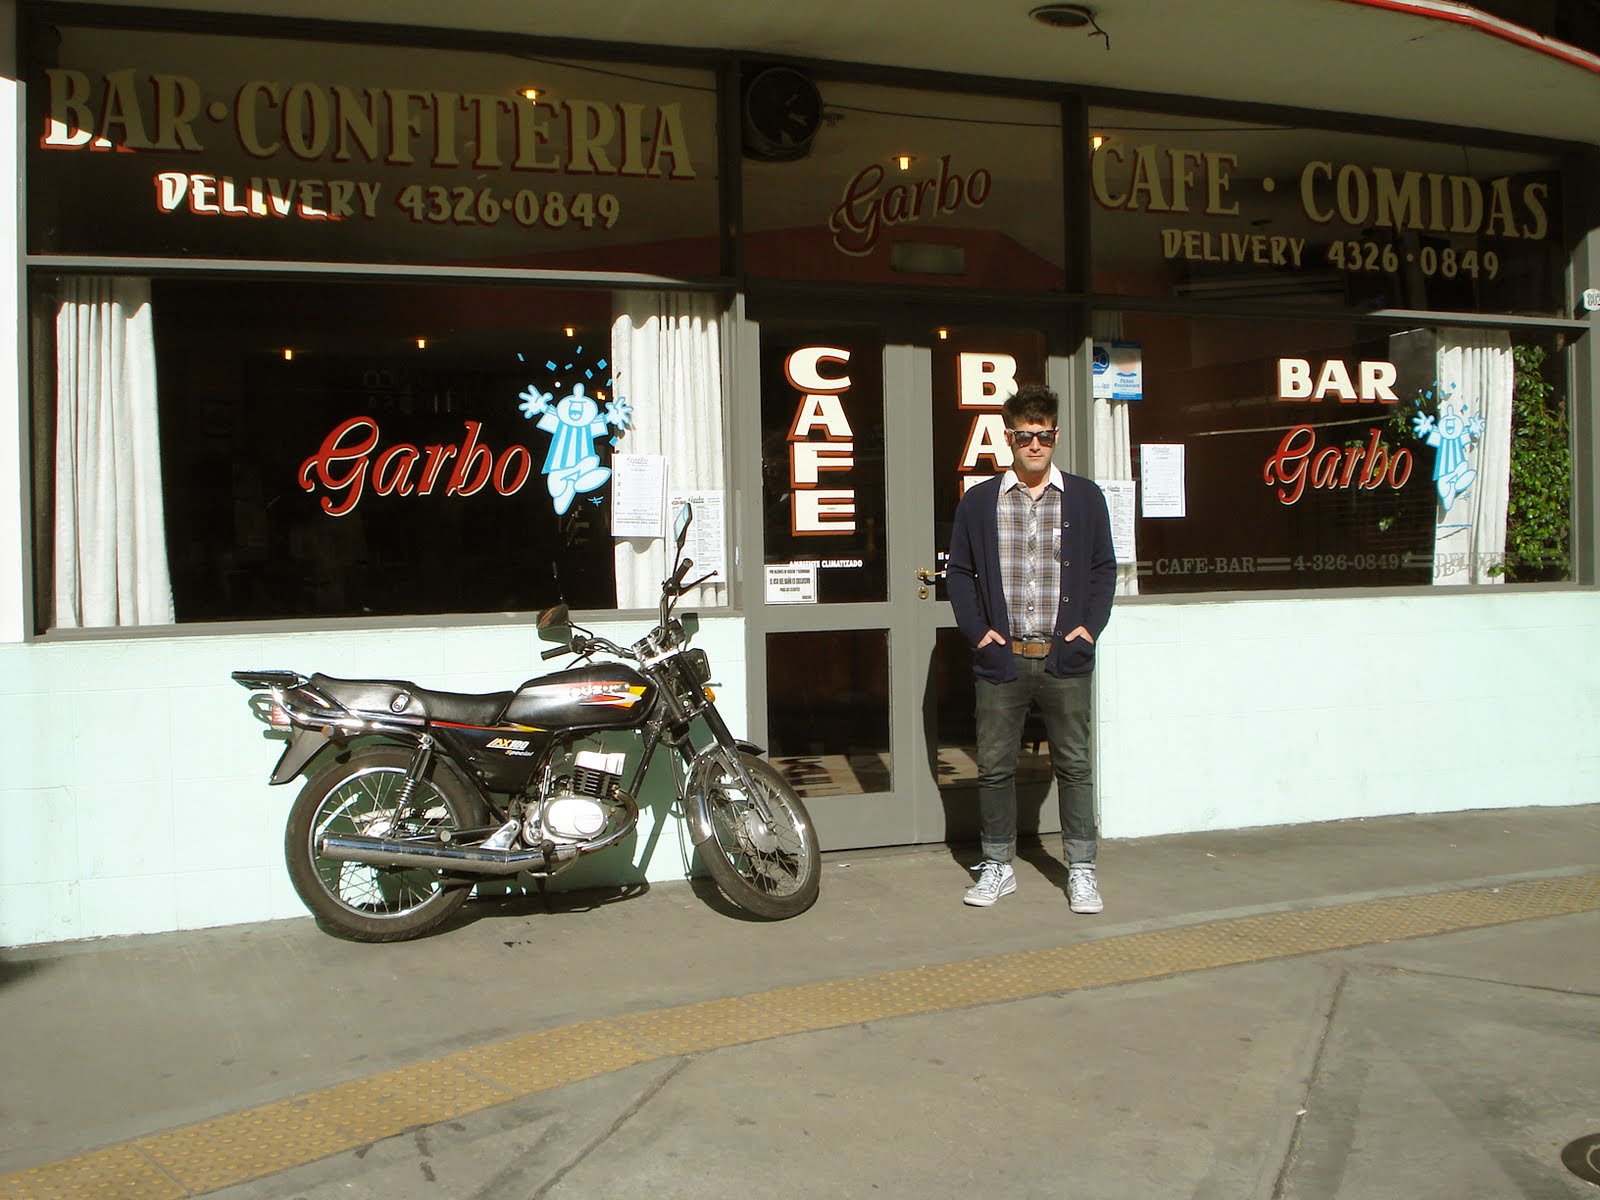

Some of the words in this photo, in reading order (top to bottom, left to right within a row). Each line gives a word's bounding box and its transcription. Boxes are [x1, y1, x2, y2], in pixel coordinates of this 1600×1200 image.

[154, 170, 382, 222] DELIVERY
[829, 155, 992, 258] Garbo
[1091, 141, 1241, 217] CAFE
[1299, 160, 1549, 242] COMIDAS
[1161, 228, 1306, 268] DELIVERY
[1277, 358, 1399, 404] BAR
[298, 416, 532, 517] Garbo
[785, 346, 856, 536] CAFE
[1263, 424, 1414, 506] Garbo
[1154, 556, 1256, 576] CAFE-BAR
[1293, 553, 1400, 572] 4-326-0849
